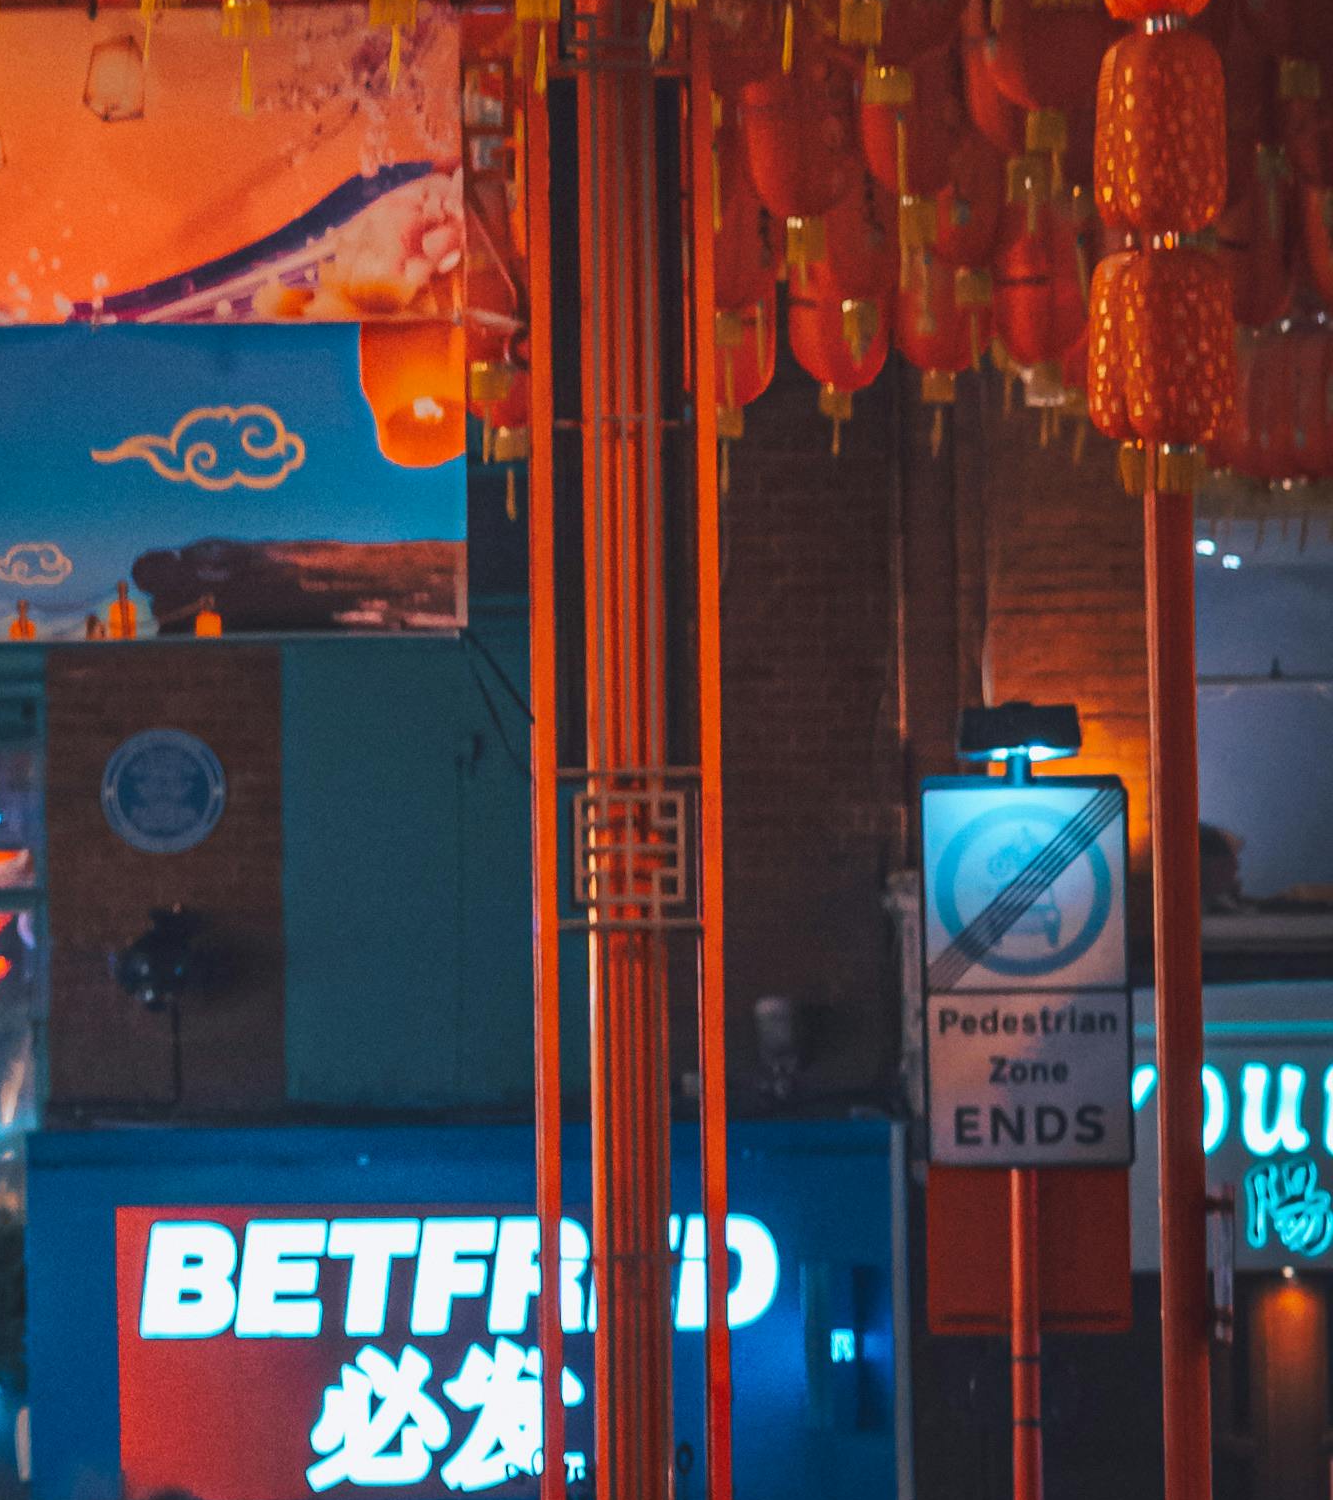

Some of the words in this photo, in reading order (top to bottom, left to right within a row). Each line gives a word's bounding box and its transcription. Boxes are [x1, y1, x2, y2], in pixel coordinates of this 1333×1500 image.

[937, 1005, 1120, 1037] Pedestrian
[987, 1055, 1070, 1086] Zone
[953, 1105, 1106, 1148] ENDS
[137, 1214, 781, 1341] BETFRD
